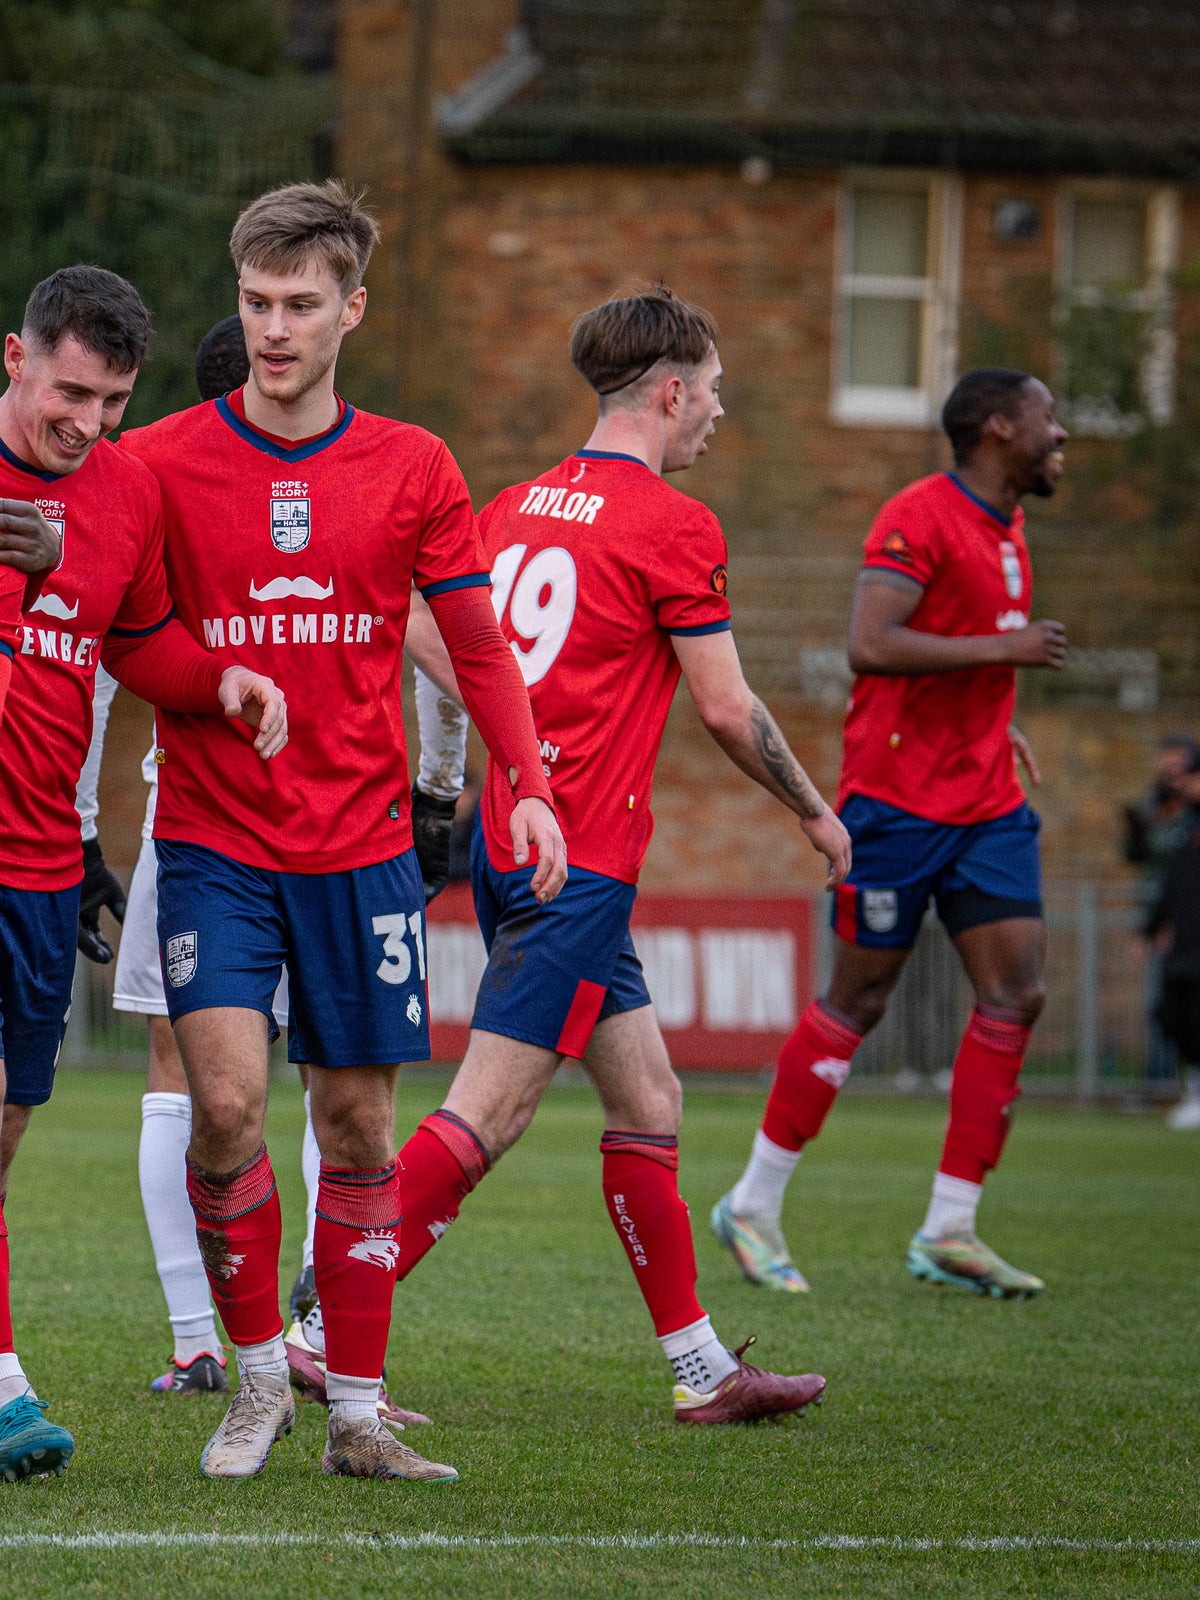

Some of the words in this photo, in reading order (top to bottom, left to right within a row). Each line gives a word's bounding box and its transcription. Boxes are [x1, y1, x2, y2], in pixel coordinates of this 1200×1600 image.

[271, 481, 309, 489] HOPE+
[271, 489, 308, 497] GLORY
[518, 486, 605, 525] TAYLOR
[490, 544, 577, 687] 19
[372, 911, 426, 984] 31
[613, 1194, 648, 1266] BEAVERS
